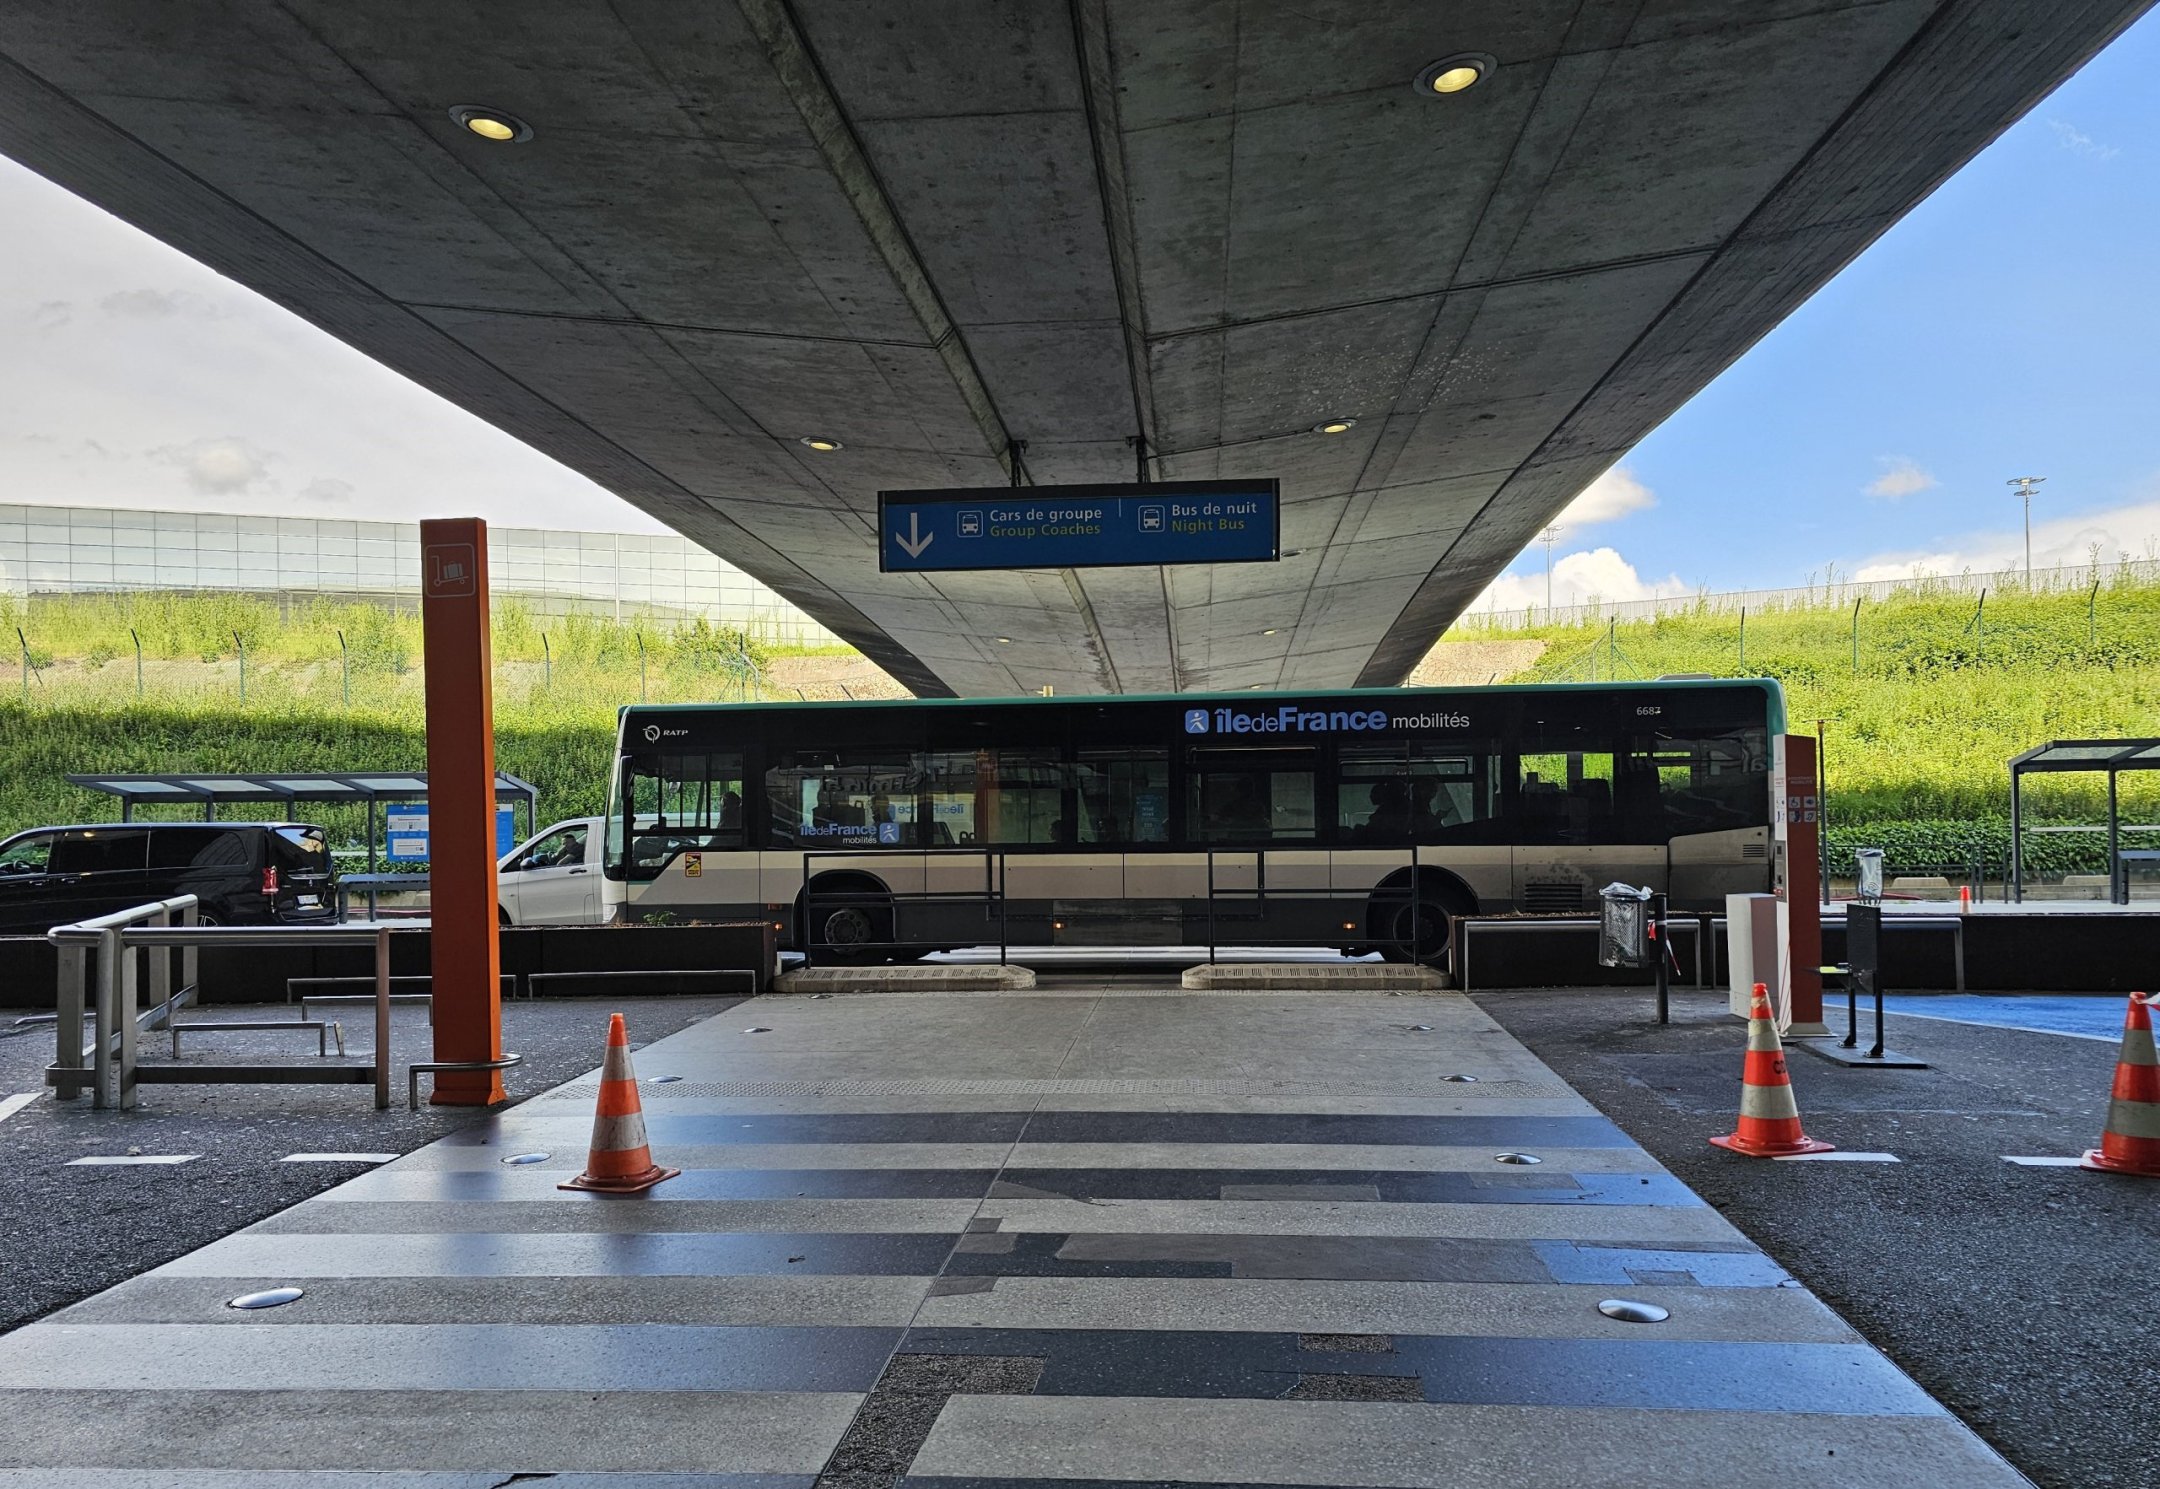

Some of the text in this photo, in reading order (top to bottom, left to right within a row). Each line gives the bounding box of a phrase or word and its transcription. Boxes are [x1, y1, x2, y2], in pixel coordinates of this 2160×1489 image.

[990, 508, 1102, 523] Cars de groupe
[1172, 501, 1257, 516] Bus de nuit
[990, 523, 1101, 539] Group Coaches
[1172, 518, 1245, 534] Night Bus
[1392, 711, 1470, 729] mobilités
[842, 836, 878, 844] mobilités
